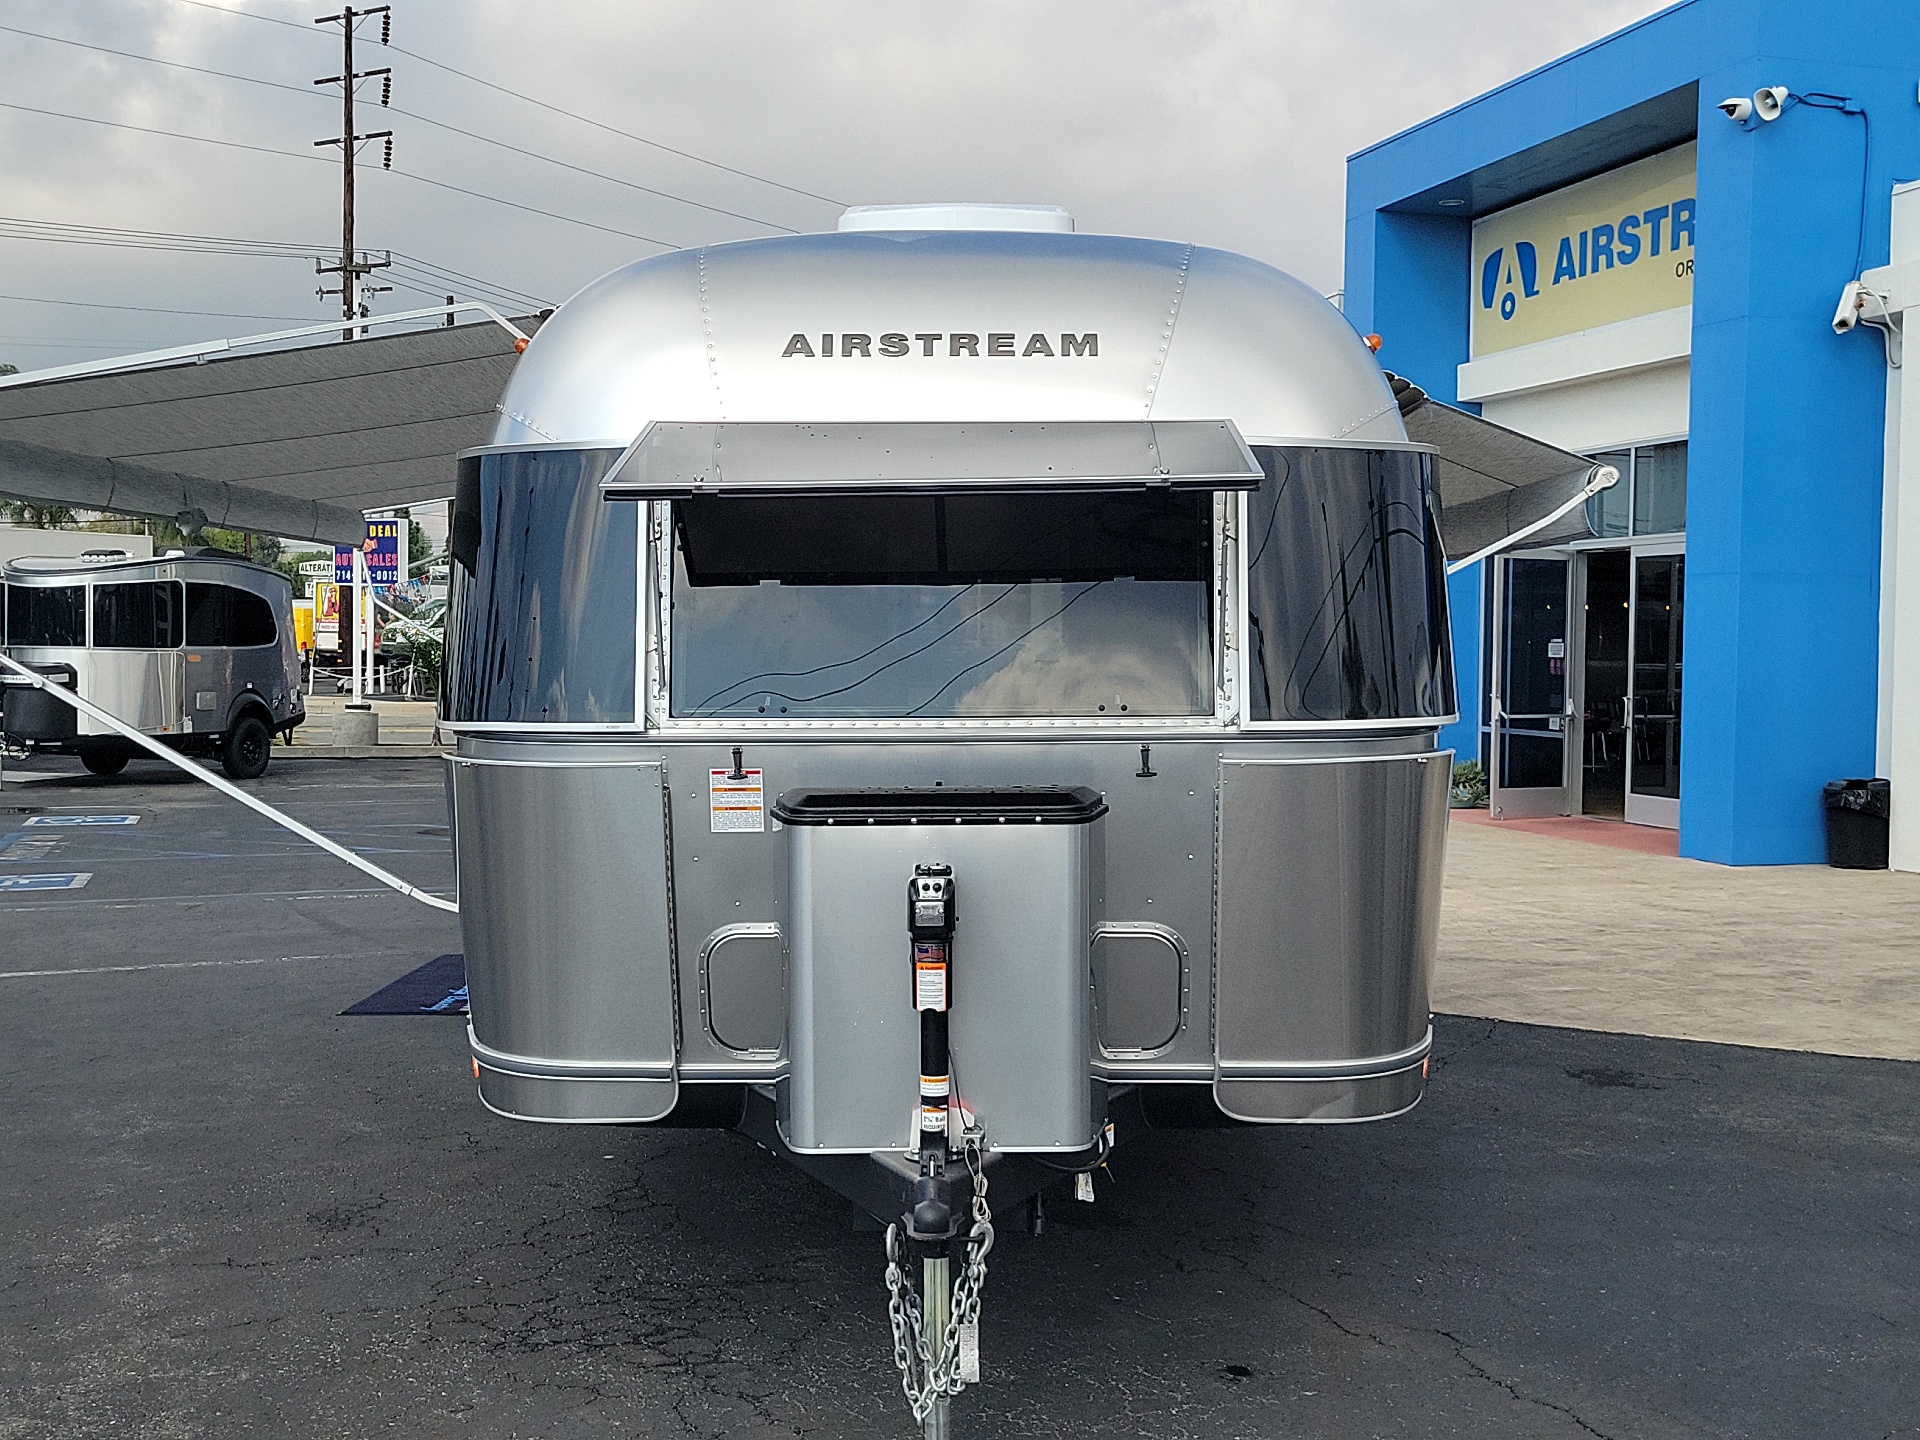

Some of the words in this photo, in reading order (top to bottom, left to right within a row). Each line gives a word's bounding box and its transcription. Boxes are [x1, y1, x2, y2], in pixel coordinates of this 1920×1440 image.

[1552, 198, 1695, 286] AIRSTR
[782, 333, 1098, 357] AIRSTREAM
[369, 525, 398, 537] DEAL
[336, 553, 353, 566] AUT
[366, 553, 398, 566] SALES
